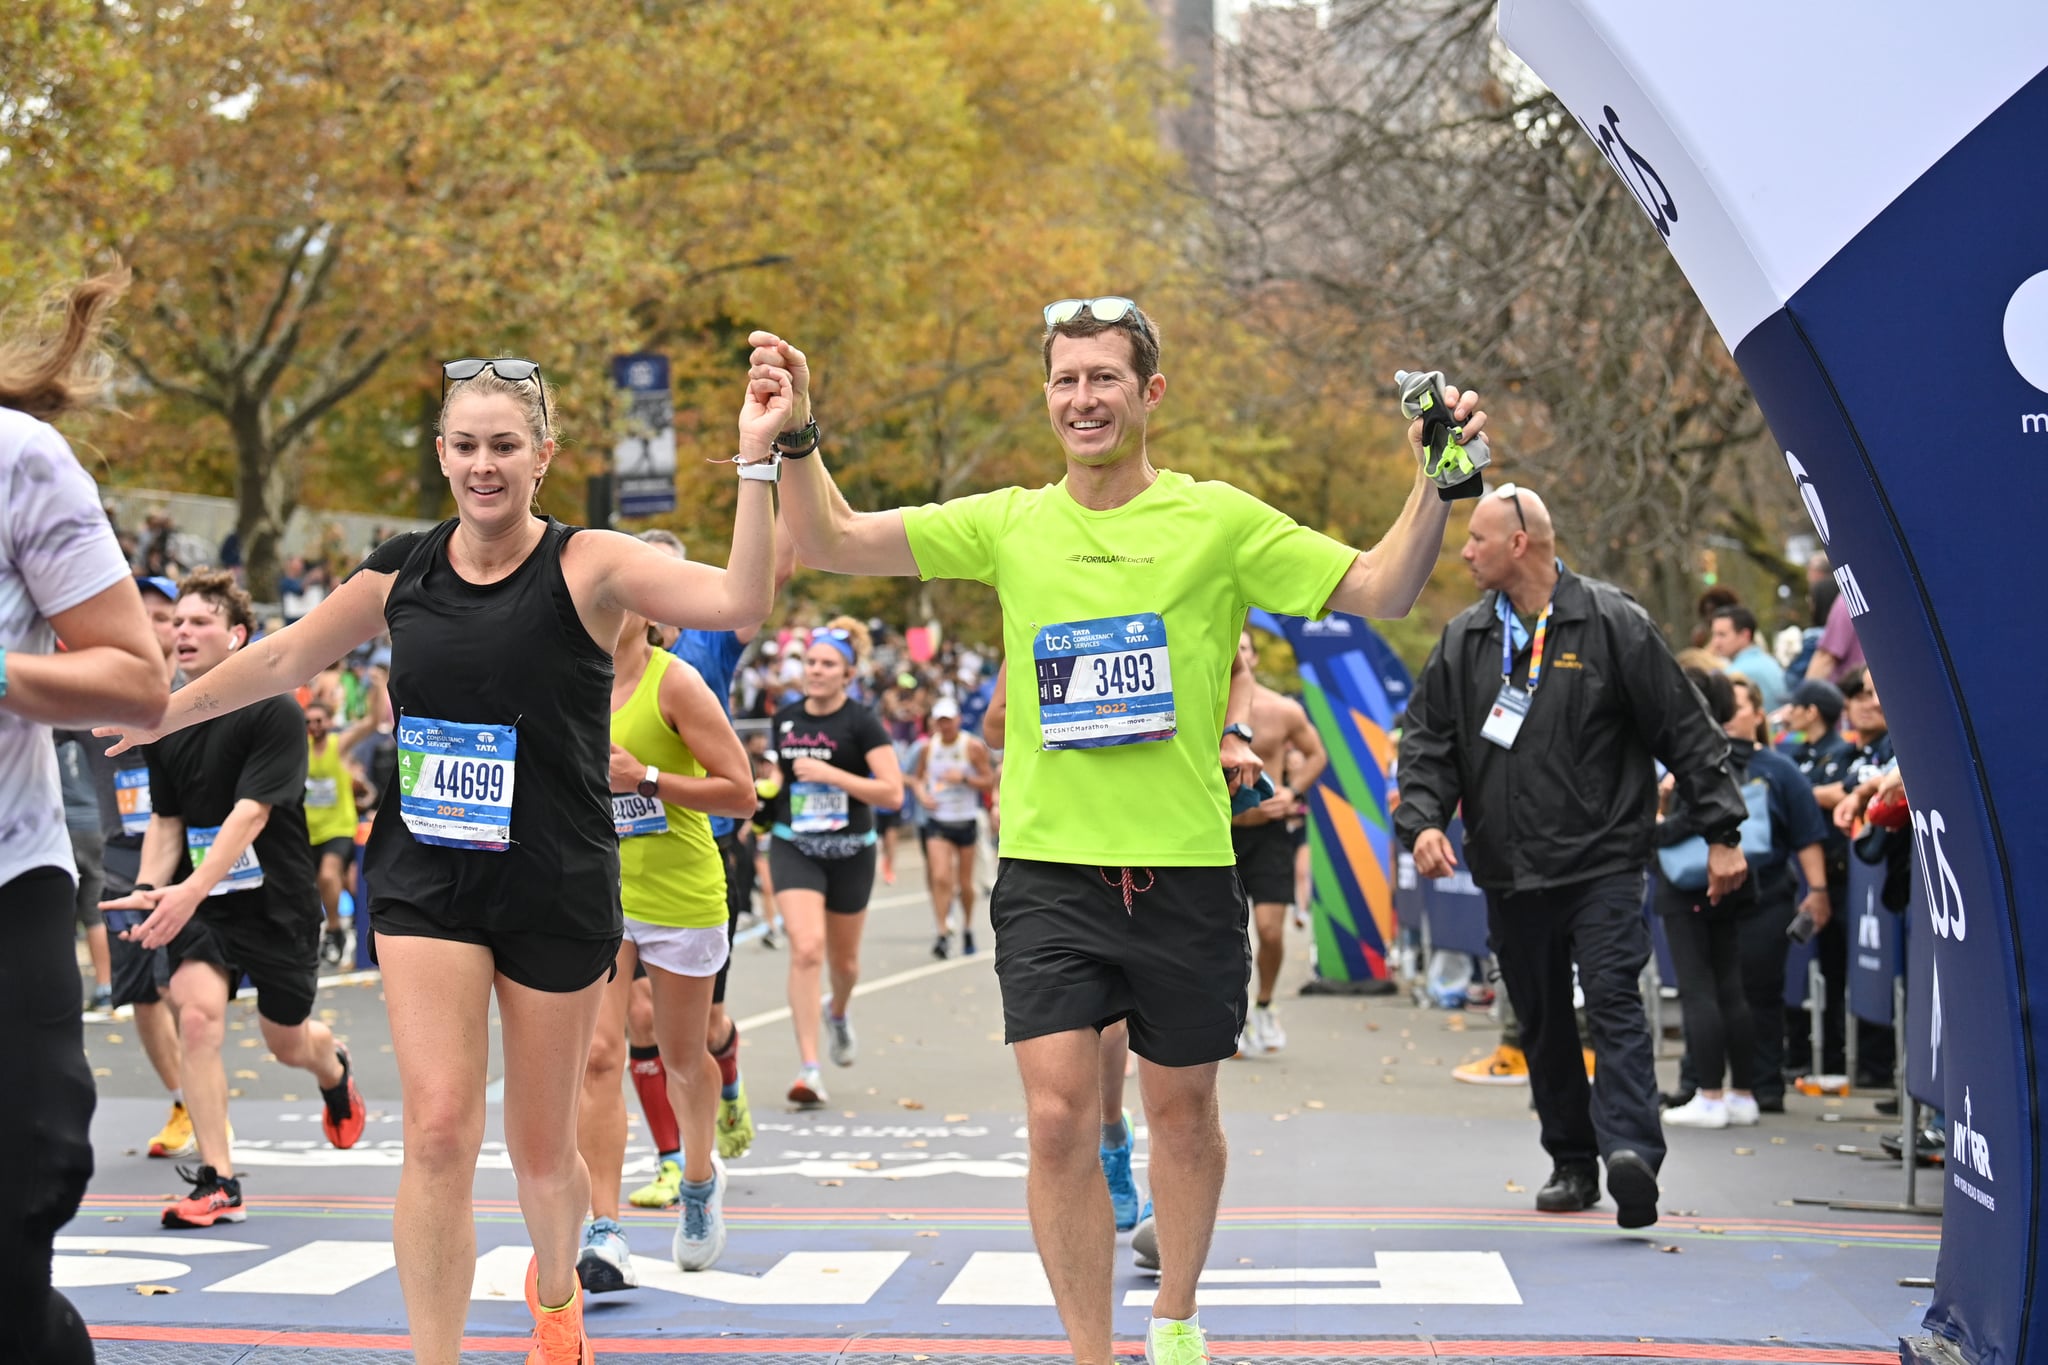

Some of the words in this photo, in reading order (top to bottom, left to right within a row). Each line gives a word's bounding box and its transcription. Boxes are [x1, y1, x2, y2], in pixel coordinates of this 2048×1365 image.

[1579, 105, 1678, 247] cs
[1045, 633, 1072, 651] tcs
[1073, 633, 1114, 643] CONSULTANCY
[1124, 634, 1149, 644] TATA
[1074, 641, 1100, 649] SERVICES
[1051, 663, 1058, 676] 1
[1093, 653, 1155, 696] 3493
[1053, 684, 1062, 698] B
[1095, 703, 1127, 715] 2022
[1045, 723, 1109, 734] #TCSNYCMarathon
[400, 725, 424, 746] tcs
[427, 735, 465, 744] CONSULTANCY
[475, 744, 498, 753] TATA
[402, 755, 411, 768] 4
[401, 776, 411, 789] C
[434, 759, 504, 802] 44699
[437, 805, 465, 817] 2022
[1910, 809, 1966, 942] cs
